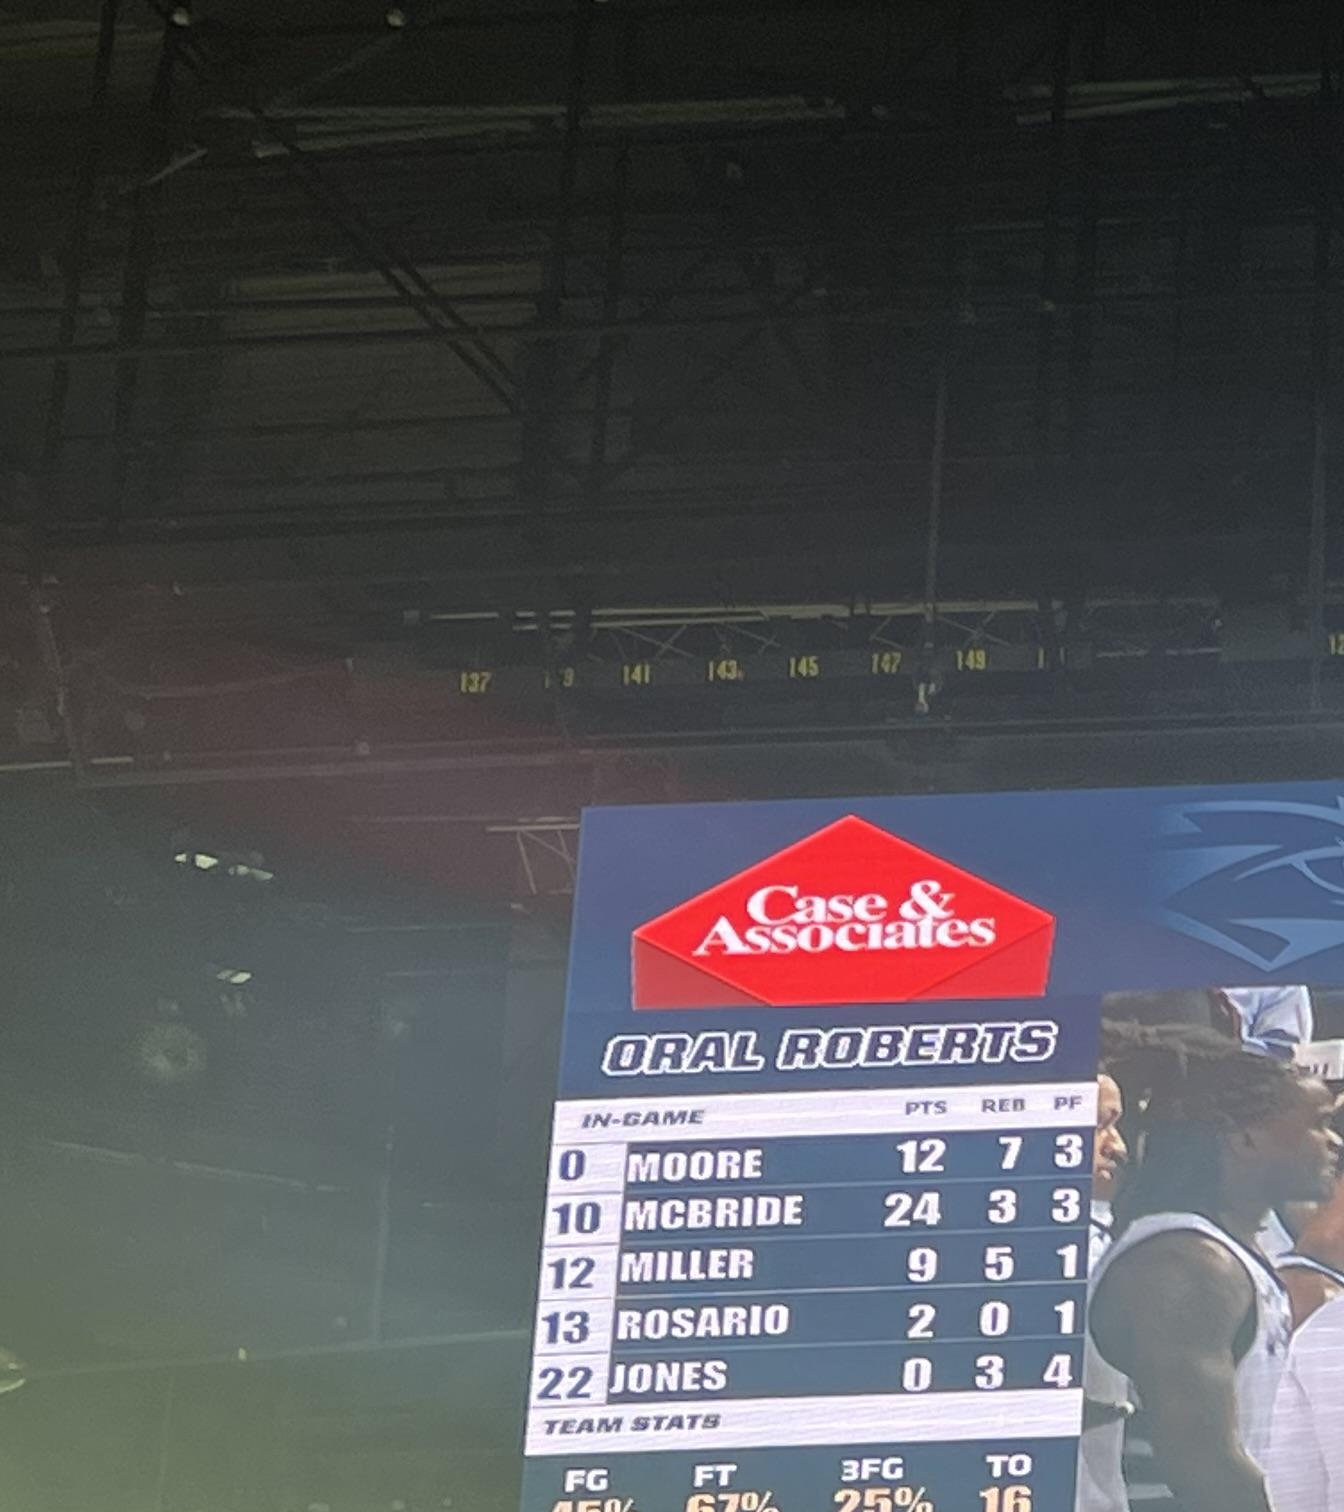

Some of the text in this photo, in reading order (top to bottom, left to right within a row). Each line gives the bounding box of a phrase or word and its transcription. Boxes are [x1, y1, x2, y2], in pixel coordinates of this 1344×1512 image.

[460, 671, 493, 695] 137
[622, 664, 651, 686] 141
[708, 660, 738, 682] 143
[788, 656, 820, 679] 145
[746, 880, 954, 926] Case &
[692, 915, 996, 957] Associates
[602, 1022, 1058, 1076] ORAL ROBERTS
[581, 1100, 946, 1129] IN-GAME PTS
[559, 1135, 1082, 1182] 0 MOORE 12 7 3
[551, 1188, 1080, 1234] 10 MCBRIDE 24 3 3
[547, 1245, 1076, 1289] 12 MILLER 9 5 1
[542, 1302, 1074, 1344] 13 ROSARIO 2 0 1
[538, 1355, 1071, 1399] 22 JONES 0 3 4
[544, 1414, 720, 1434] TEAM STATS
[565, 1455, 1032, 1492] FG FT 3FG TO
